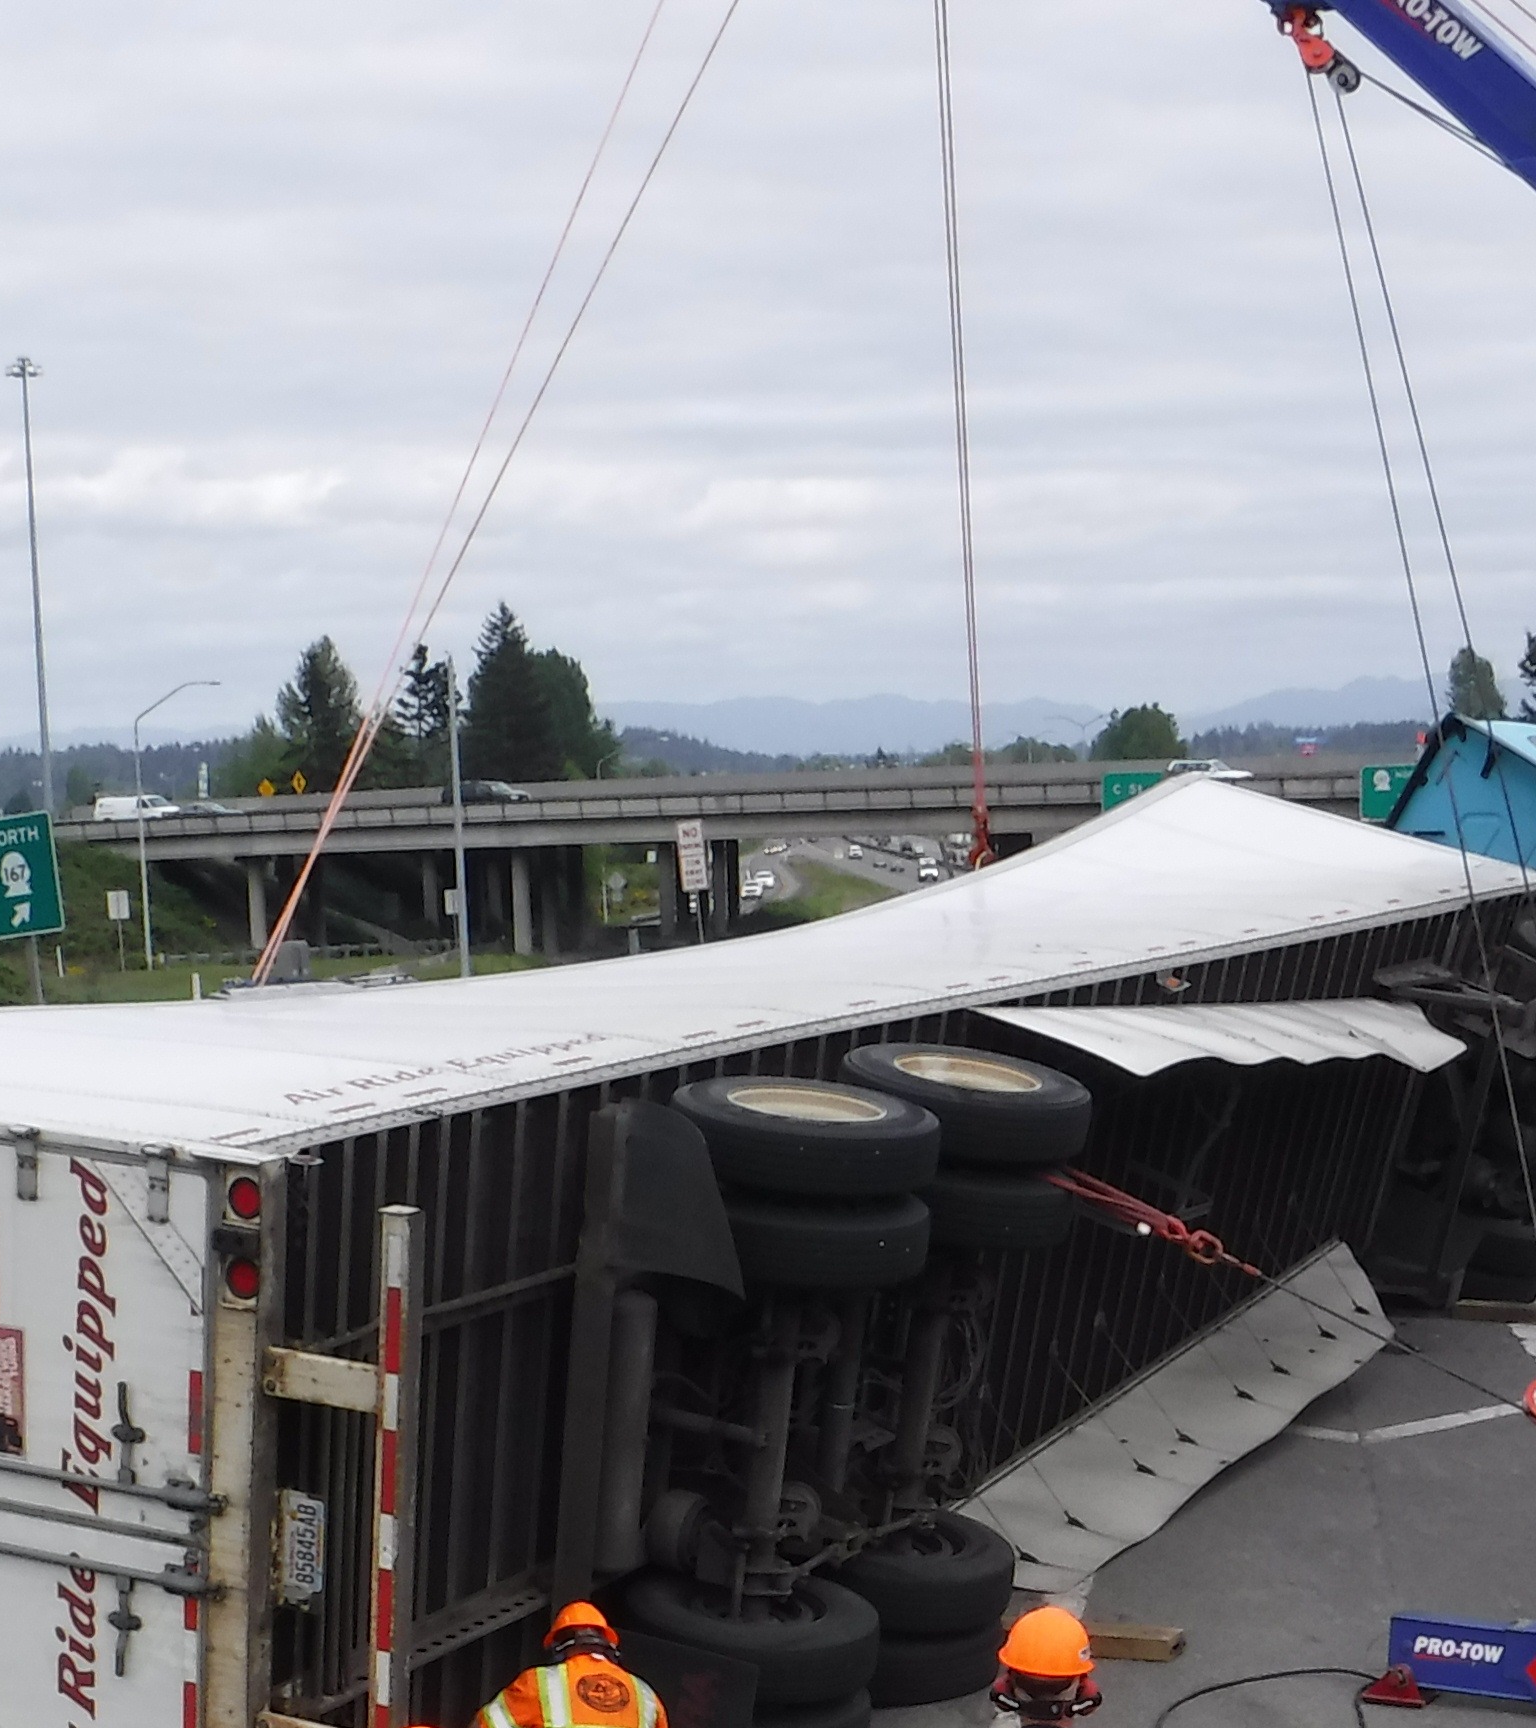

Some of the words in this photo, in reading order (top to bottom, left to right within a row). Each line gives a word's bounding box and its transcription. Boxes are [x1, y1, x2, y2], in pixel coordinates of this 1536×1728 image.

[1394, 0, 1484, 60] O-TOW
[1112, 784, 1122, 795] C
[3, 863, 26, 882] 167
[284, 1085, 344, 1106] Air
[347, 1066, 436, 1090] Ride
[445, 1032, 607, 1071] Equipped
[61, 1156, 117, 1516] Equipped
[55, 1551, 97, 1721] Ride
[1413, 1635, 1505, 1664] PRO-TOW
